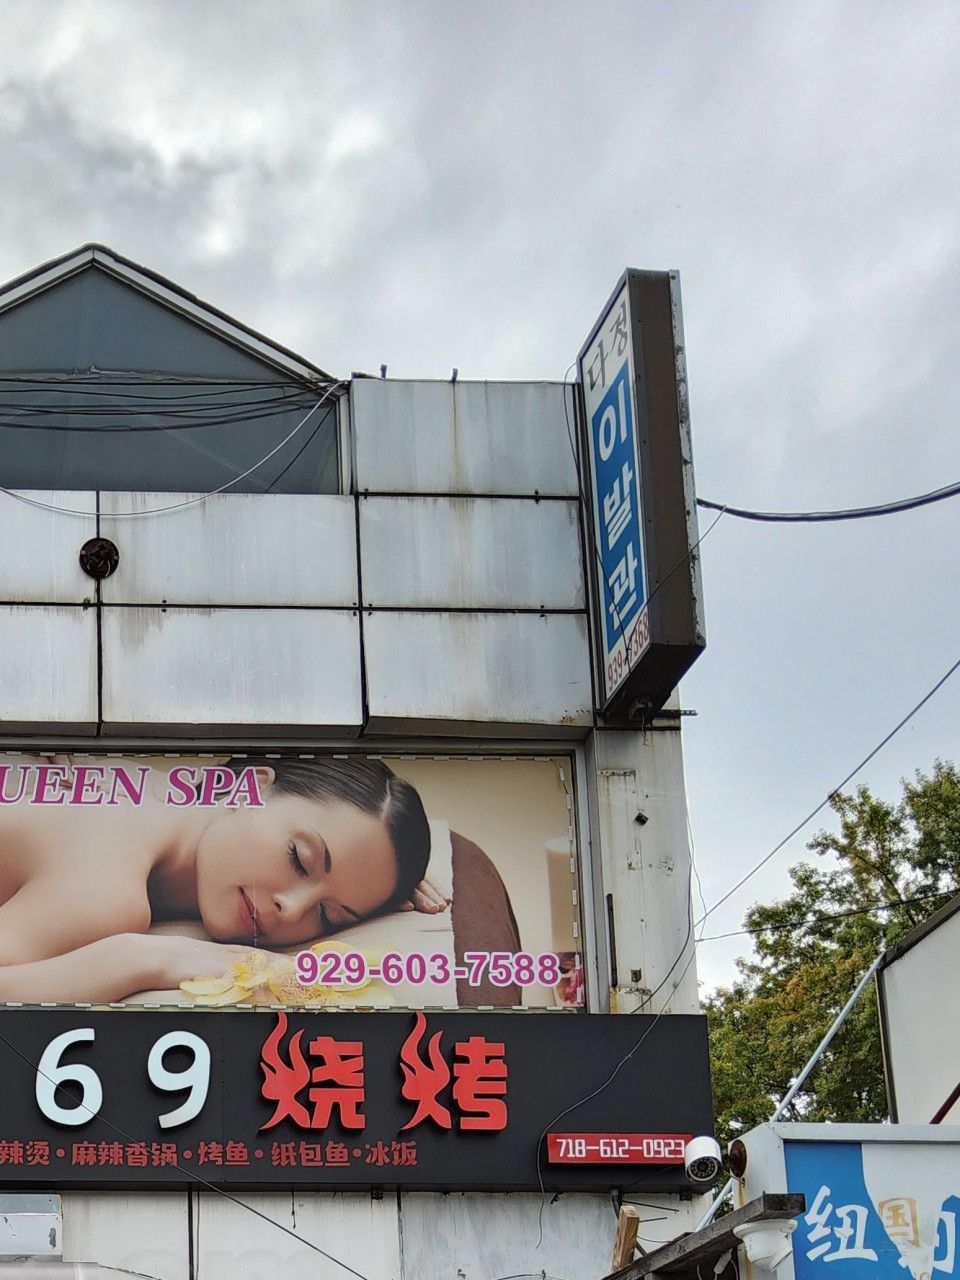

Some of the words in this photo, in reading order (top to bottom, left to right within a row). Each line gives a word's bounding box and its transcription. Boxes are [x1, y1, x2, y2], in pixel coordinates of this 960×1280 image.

[598, 379, 637, 633] 이발관
[166, 765, 265, 809] SPA
[296, 951, 561, 988] 929-603-7588
[258, 1011, 508, 1132] 烧烤
[556, 1138, 685, 1158] 718-612-0923
